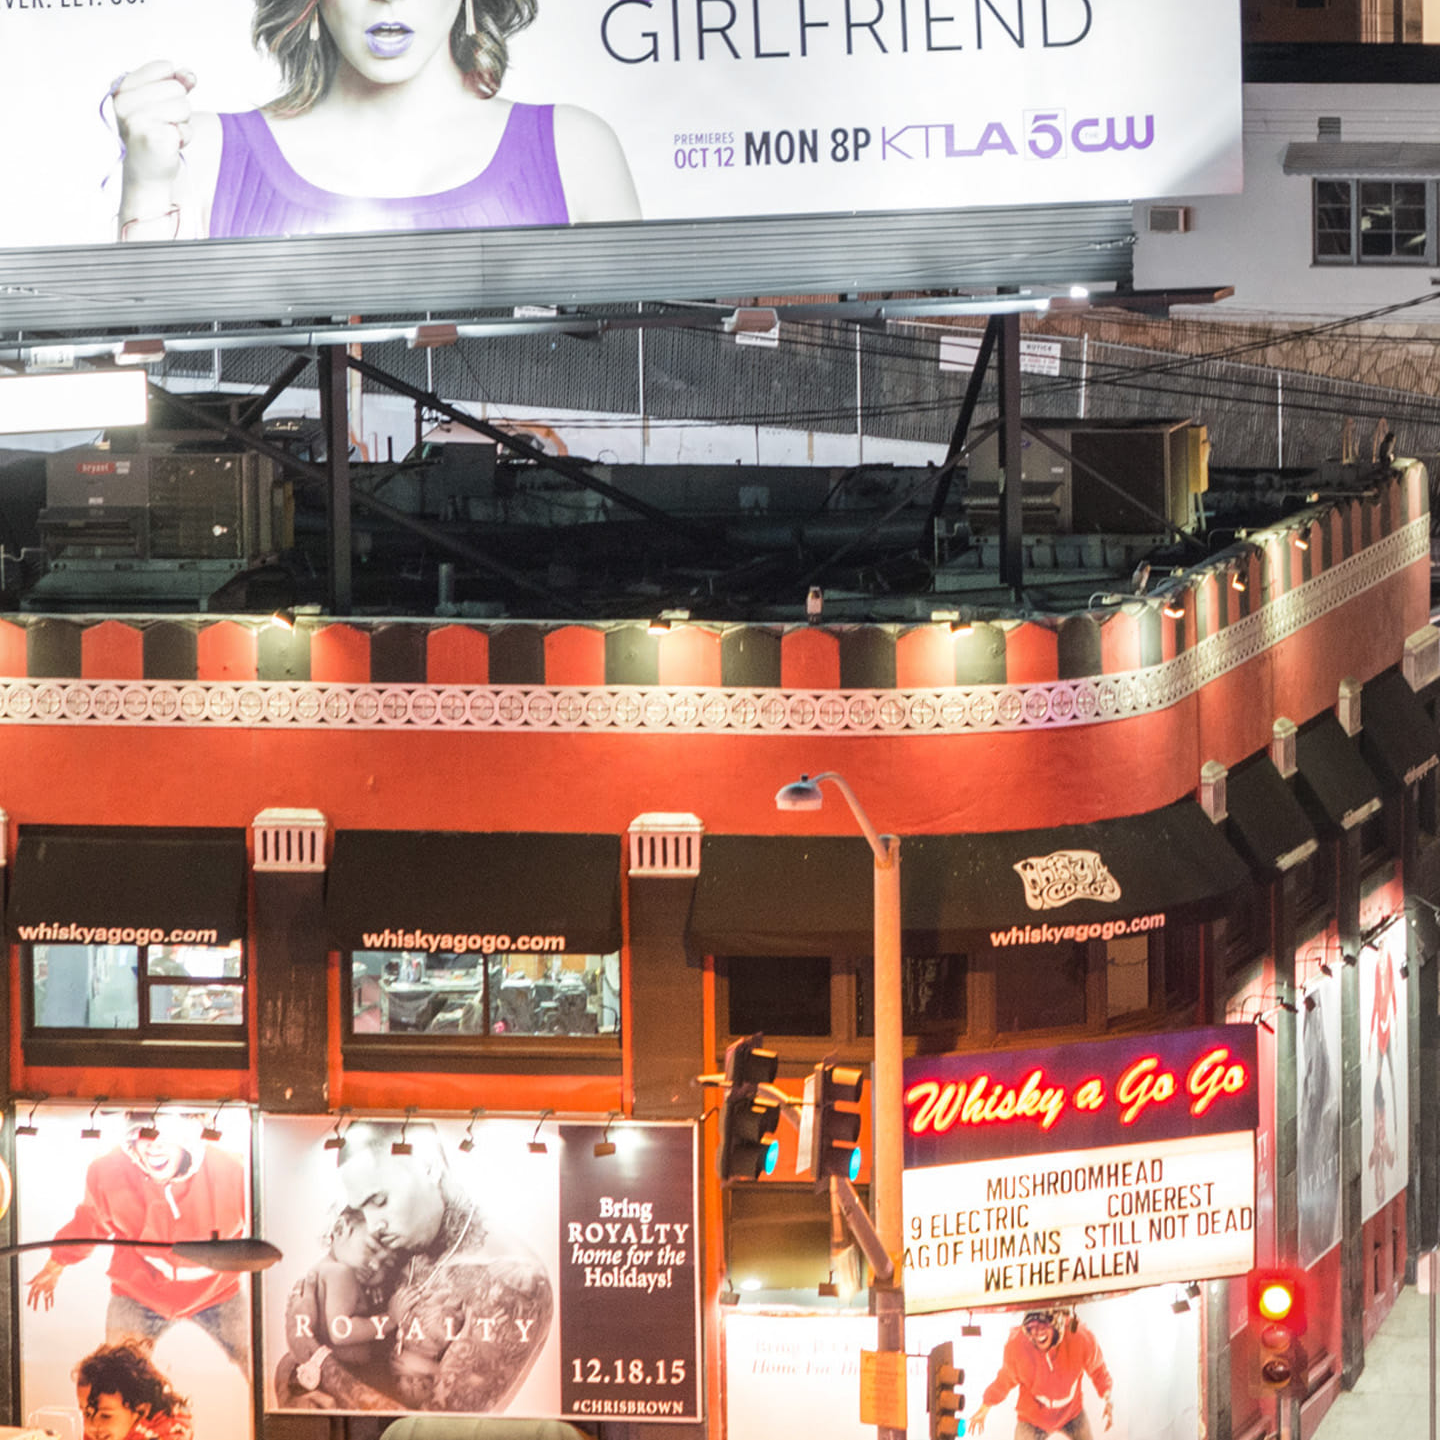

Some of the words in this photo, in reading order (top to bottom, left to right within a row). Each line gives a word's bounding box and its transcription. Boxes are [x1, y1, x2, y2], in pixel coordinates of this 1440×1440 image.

[674, 132, 735, 145] PREMIERES
[745, 128, 818, 166] MON
[830, 127, 871, 162] 8P
[881, 122, 1017, 160] KTLA
[1028, 113, 1063, 159] 5
[1071, 114, 1155, 153] CW
[674, 147, 709, 169] OCT
[714, 146, 735, 168] 12
[18, 922, 218, 944] whiskyagogo.com
[363, 929, 566, 953] whiskyagogo.com
[989, 912, 1166, 947] whiskyagogo.com
[906, 1065, 1064, 1133] Whisky
[1076, 1077, 1103, 1111] a
[1119, 1057, 1174, 1123] Go
[1189, 1049, 1248, 1116] Go
[986, 1157, 1163, 1202] MUSHROOMHEAD
[599, 1197, 653, 1224] Bring
[1106, 1182, 1216, 1219] COMEREST
[568, 1222, 689, 1245] ROYALTY
[911, 1215, 923, 1240] 9
[931, 1203, 1030, 1239] ELECTRIC
[1084, 1221, 1142, 1250] STILL
[1148, 1213, 1192, 1242] NOT
[1197, 1206, 1254, 1238] DEAD
[571, 1245, 622, 1266] home
[626, 1244, 654, 1273] for
[657, 1244, 686, 1266] the
[936, 1241, 965, 1266] OF
[971, 1229, 1062, 1263] HUMANS
[583, 1266, 673, 1290] Holidays!
[294, 1315, 537, 1343] ROYALTY
[570, 1358, 686, 1386] 12.18.15
[572, 1399, 684, 1415] #CHRISBROWN
